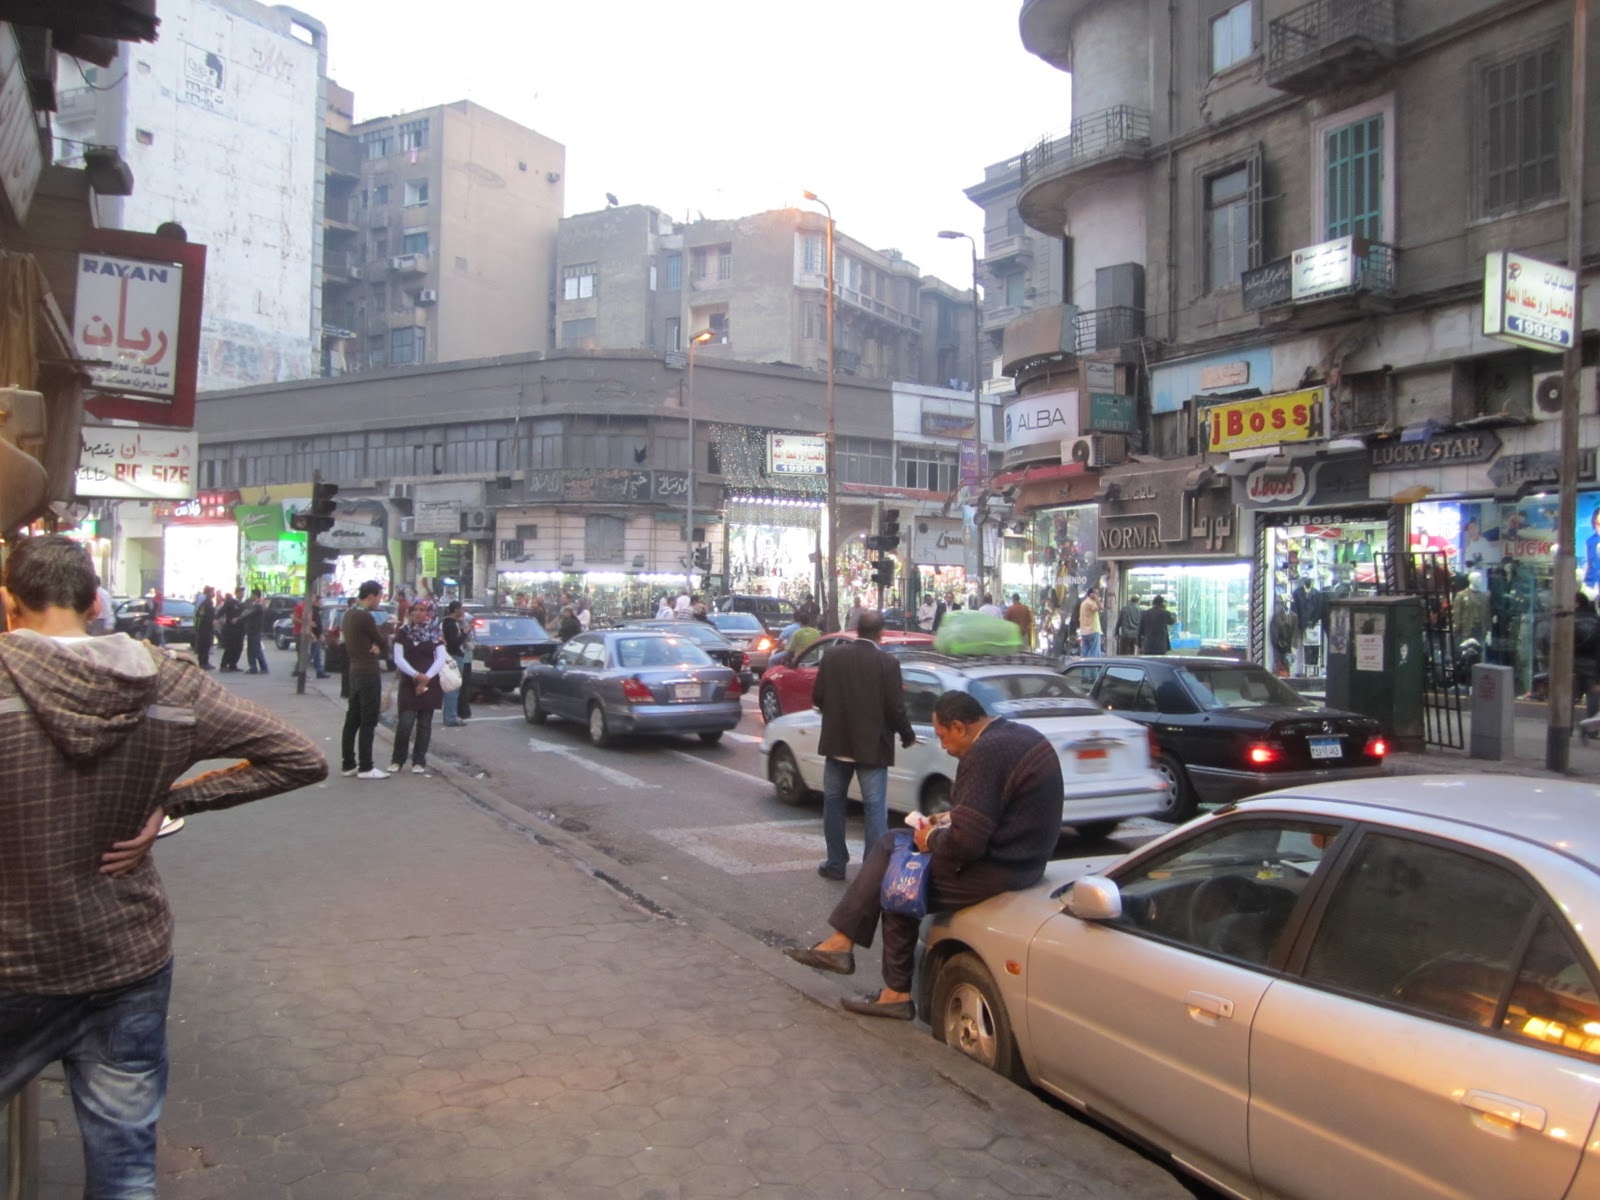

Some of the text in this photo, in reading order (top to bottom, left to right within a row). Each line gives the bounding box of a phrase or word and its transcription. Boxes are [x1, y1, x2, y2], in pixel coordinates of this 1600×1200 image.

[83, 258, 168, 283] RAYAN
[82, 274, 168, 365] ريان
[1515, 319, 1561, 342] 19955
[130, 364, 170, 378] ساعات
[1017, 407, 1066, 432] ALBA
[1095, 420, 1129, 430] ORIENT
[1372, 437, 1480, 464] LUCKY STAR
[152, 465, 190, 483] SIZE
[782, 464, 816, 473] 19955
[1190, 497, 1231, 550] نورما
[1100, 526, 1160, 550] NORMA
